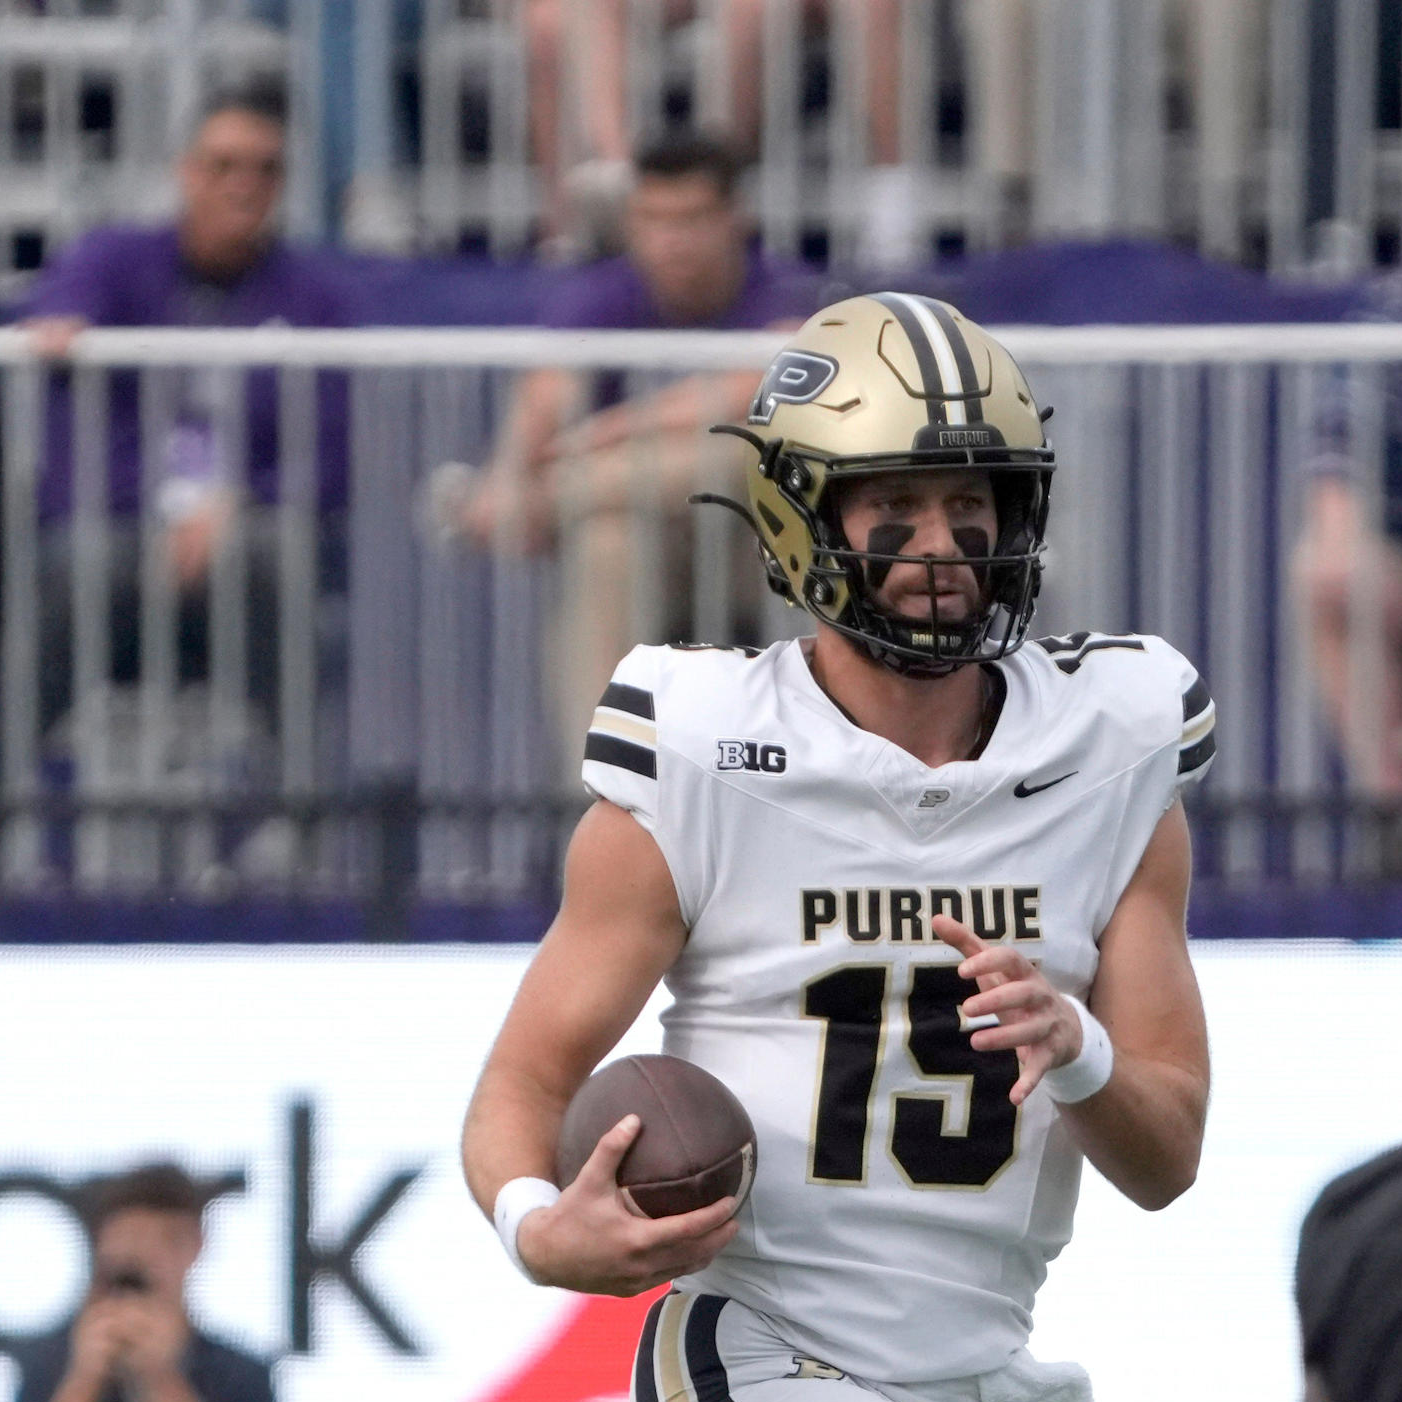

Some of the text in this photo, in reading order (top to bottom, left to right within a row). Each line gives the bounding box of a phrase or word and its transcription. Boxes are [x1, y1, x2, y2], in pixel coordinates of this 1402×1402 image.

[748, 349, 840, 426] P
[938, 430, 990, 447] PURDUE
[912, 633, 947, 647] BOILR
[801, 886, 1042, 941] PURDUE
[801, 960, 1038, 1190] 15
